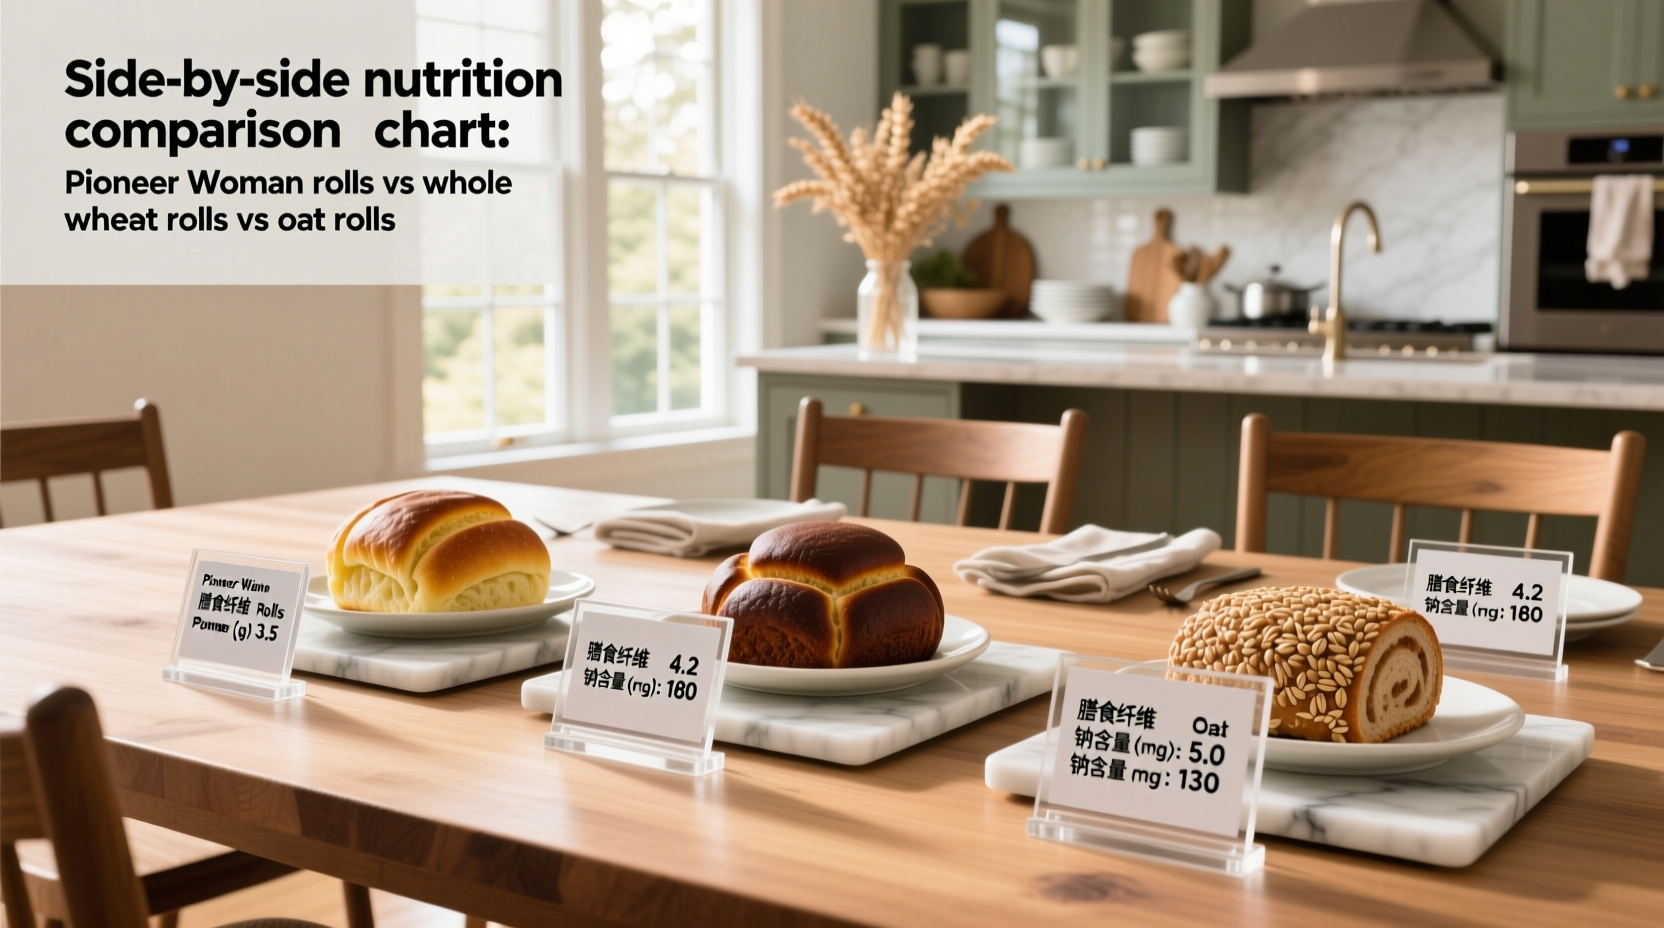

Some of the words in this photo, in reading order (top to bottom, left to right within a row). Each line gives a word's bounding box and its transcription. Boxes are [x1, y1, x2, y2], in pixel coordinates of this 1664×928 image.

[1511, 582, 1544, 602] 4.2
[256, 602, 286, 620] Rolls
[1509, 604, 1544, 624] 180
[232, 619, 252, 642] (g)
[254, 622, 280, 642] 3.5
[669, 653, 700, 677] 4.2
[666, 679, 698, 701] 180
[1075, 698, 1158, 732] 膳食纤维
[1192, 716, 1230, 739] Oat
[1188, 740, 1226, 767] 5.0
[1069, 751, 1128, 782] 钠含量
[1178, 768, 1220, 795] 130
